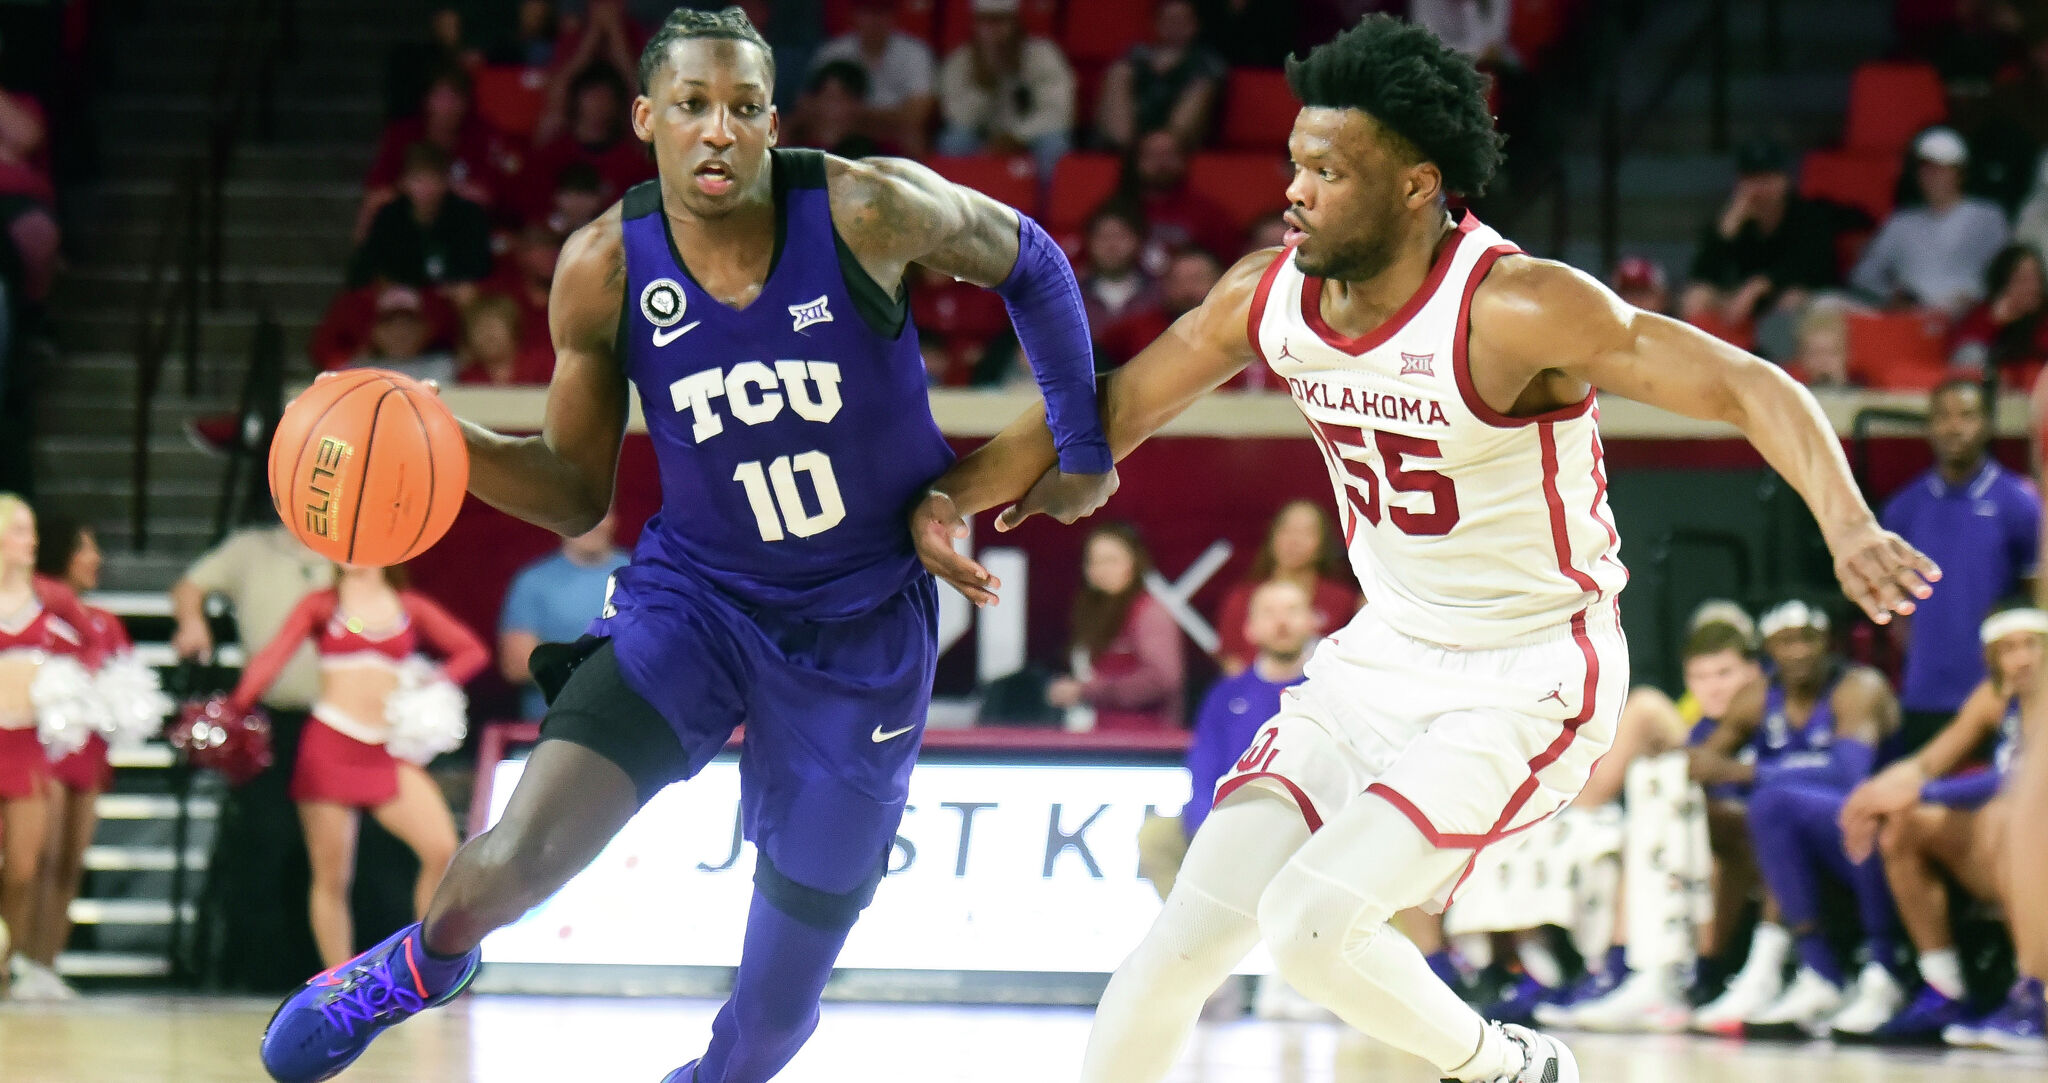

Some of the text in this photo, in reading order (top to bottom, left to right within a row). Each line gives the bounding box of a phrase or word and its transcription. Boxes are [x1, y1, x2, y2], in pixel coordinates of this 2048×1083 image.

[669, 360, 843, 443] TCU
[1288, 377, 1451, 427] OKLAHOMA
[304, 436, 346, 539] ELITE
[733, 450, 846, 542] 10
[1316, 419, 1460, 535] 55
[696, 799, 998, 877] JST
